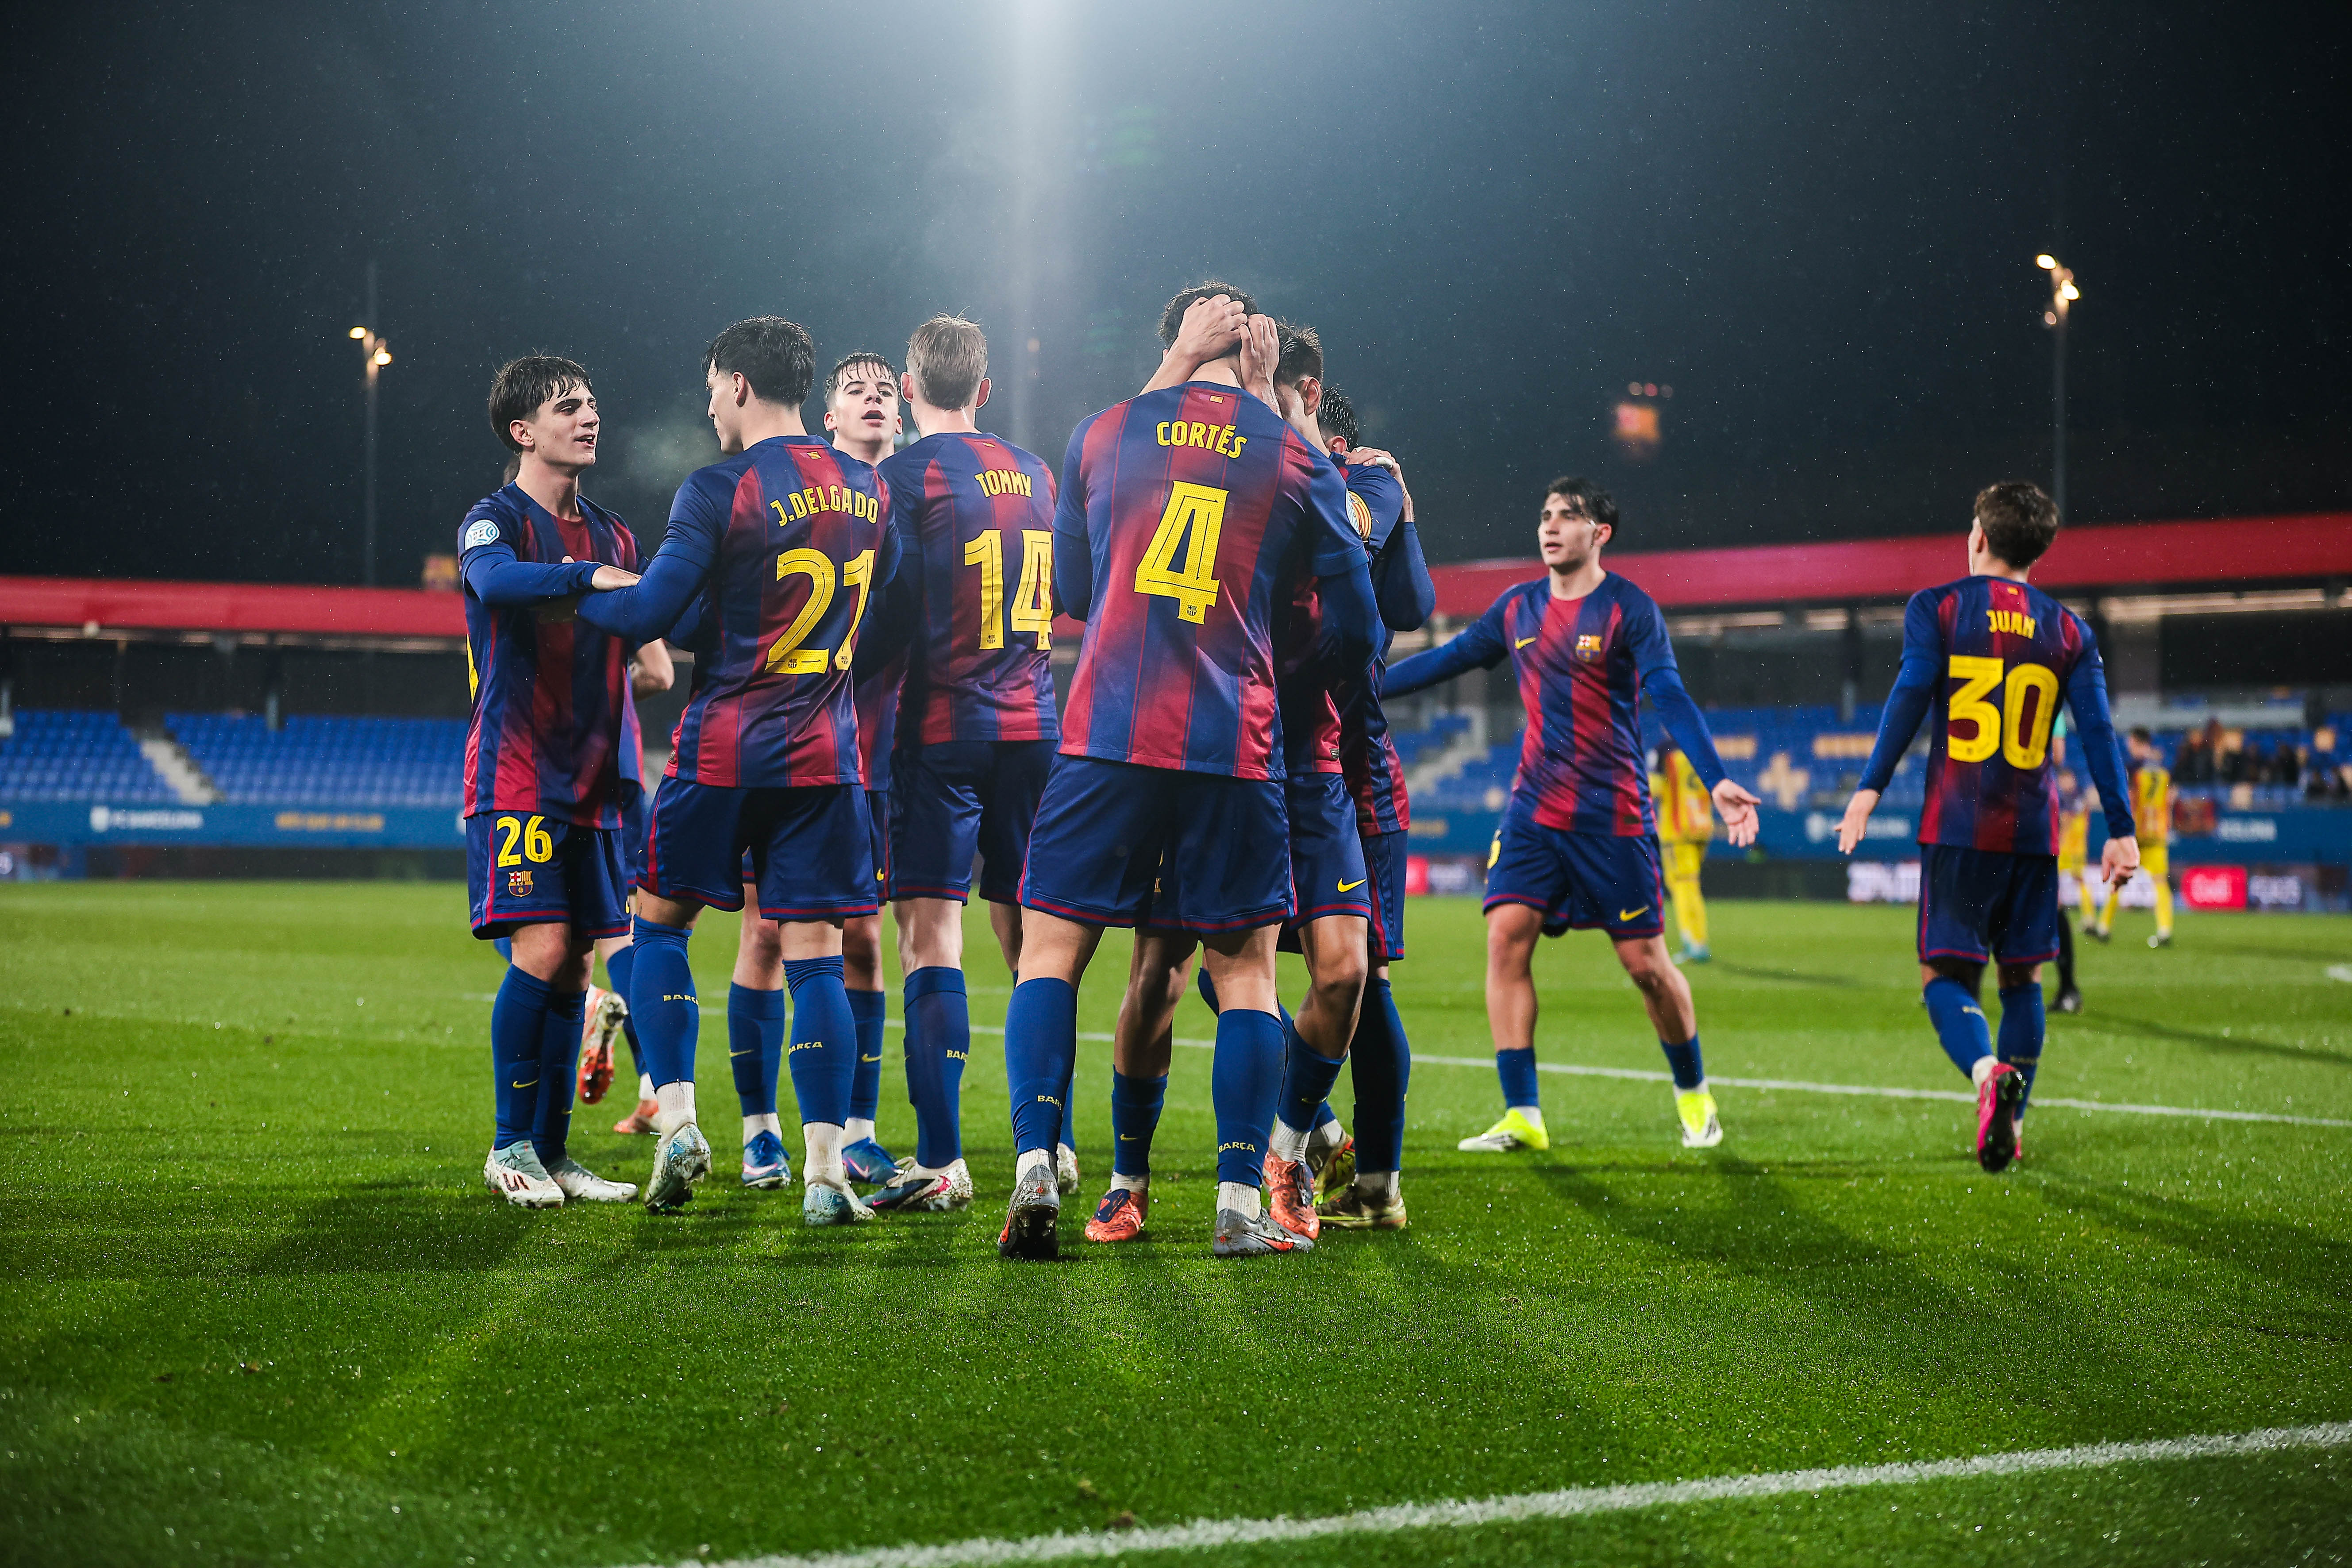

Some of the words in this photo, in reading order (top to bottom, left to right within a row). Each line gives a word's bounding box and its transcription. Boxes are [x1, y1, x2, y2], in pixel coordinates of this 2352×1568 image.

[1157, 421, 1247, 458] CORTÉS
[974, 469, 1032, 497] TOMMY
[770, 485, 878, 527] J.DELGADO
[1134, 480, 1230, 624] 4
[964, 529, 1053, 650] 14
[764, 548, 875, 674] 21
[1986, 609, 2036, 639] JUAN
[1948, 655, 2059, 769] 30
[496, 815, 552, 867] 26
[946, 1049, 968, 1063] BAR
[1218, 1142, 1256, 1153] BARÇA
